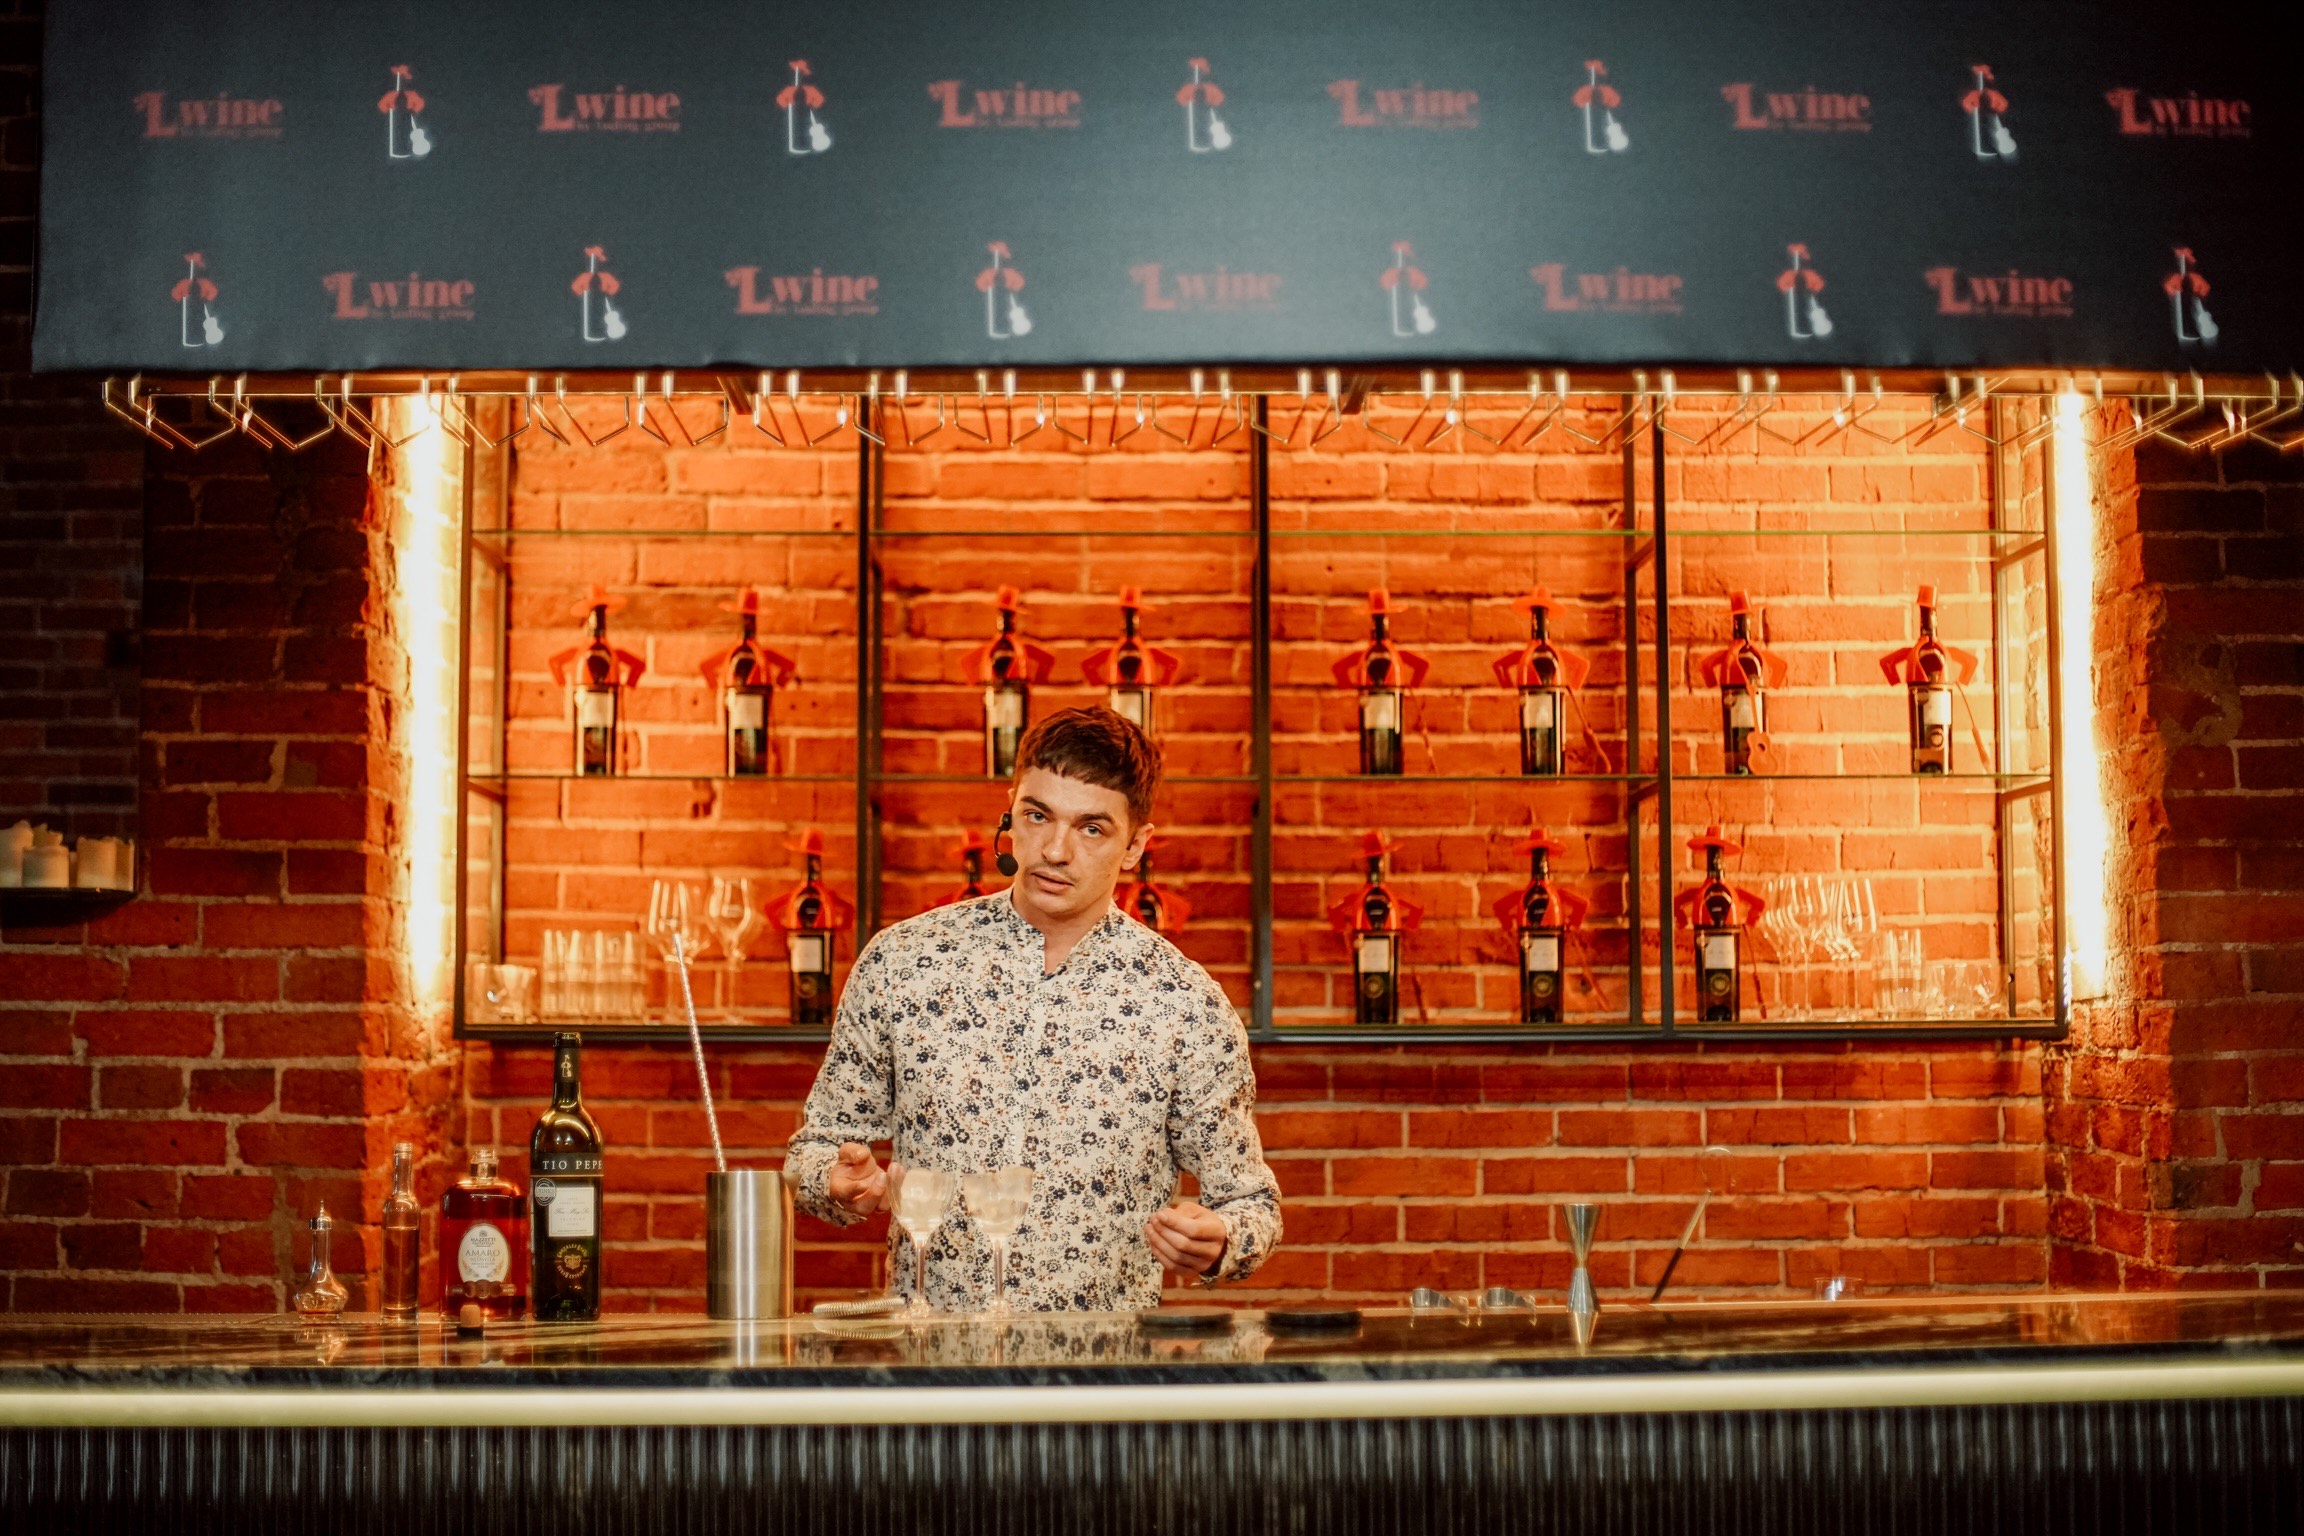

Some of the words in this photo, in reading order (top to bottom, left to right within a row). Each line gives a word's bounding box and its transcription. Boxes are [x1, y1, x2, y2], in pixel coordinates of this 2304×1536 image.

[133, 90, 283, 138] Lwine
[527, 83, 681, 132] Lwine
[927, 79, 1081, 127] Lwine
[1326, 79, 1480, 127] Lwine
[1720, 82, 1871, 130] Lwine
[2105, 87, 2252, 134] Lwine
[322, 271, 475, 319] Lwine
[724, 266, 879, 315] Lwine
[1128, 262, 1283, 310] Lwine
[1530, 262, 1683, 311] Lwine
[1923, 266, 2074, 314] Lwine
[542, 1160, 568, 1170] TIO
[575, 1160, 603, 1170] PEPE
[465, 1249, 501, 1257] AMARO
